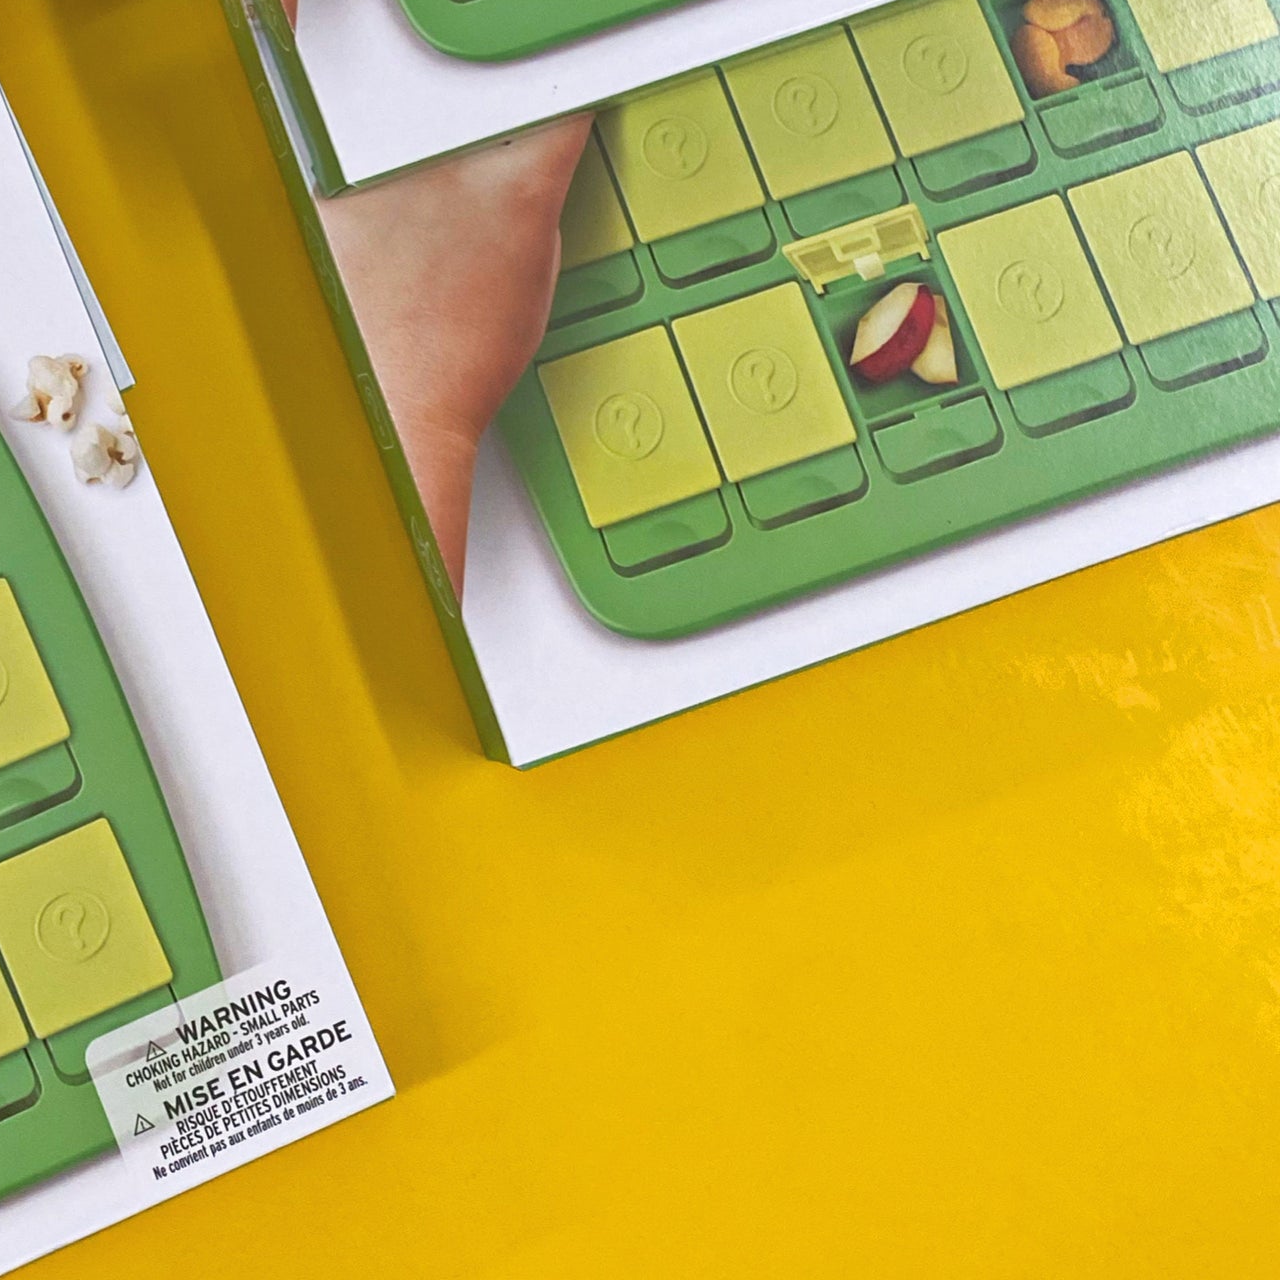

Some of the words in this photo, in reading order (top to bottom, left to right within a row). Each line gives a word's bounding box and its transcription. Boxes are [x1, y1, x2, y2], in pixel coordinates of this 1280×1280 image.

[125, 1051, 181, 1088] CHOKING
[181, 1031, 231, 1063] HAZARD
[239, 1011, 282, 1037] SMALL
[281, 990, 320, 1018] PARTS
[152, 1078, 172, 1093] Not
[172, 1071, 188, 1085] for
[188, 1053, 227, 1077] children
[227, 1039, 254, 1059] under
[255, 1031, 263, 1047] 3
[264, 1023, 290, 1045] years
[291, 1013, 310, 1030] old.
[175, 979, 292, 1045] WARNING
[160, 1128, 205, 1161] PIÈCES
[204, 1119, 224, 1140] DE
[223, 1102, 272, 1133] PETITES
[271, 1064, 348, 1109] DIMENSIONS
[163, 1077, 226, 1120] MISE
[227, 1060, 264, 1092] EN
[267, 1020, 353, 1073] GARDE
[176, 1103, 222, 1137] RISQUE
[222, 1059, 320, 1115] D'ÉTOUFFEMENT
[152, 1164, 168, 1181] Ne
[168, 1146, 210, 1174] convient
[209, 1142, 228, 1158] pas
[228, 1130, 248, 1145] aux
[247, 1112, 283, 1133] enfants
[282, 1106, 297, 1121] de
[296, 1096, 326, 1116] moins
[325, 1087, 341, 1102] de
[340, 1080, 349, 1096] 3
[348, 1073, 370, 1091] ans.
